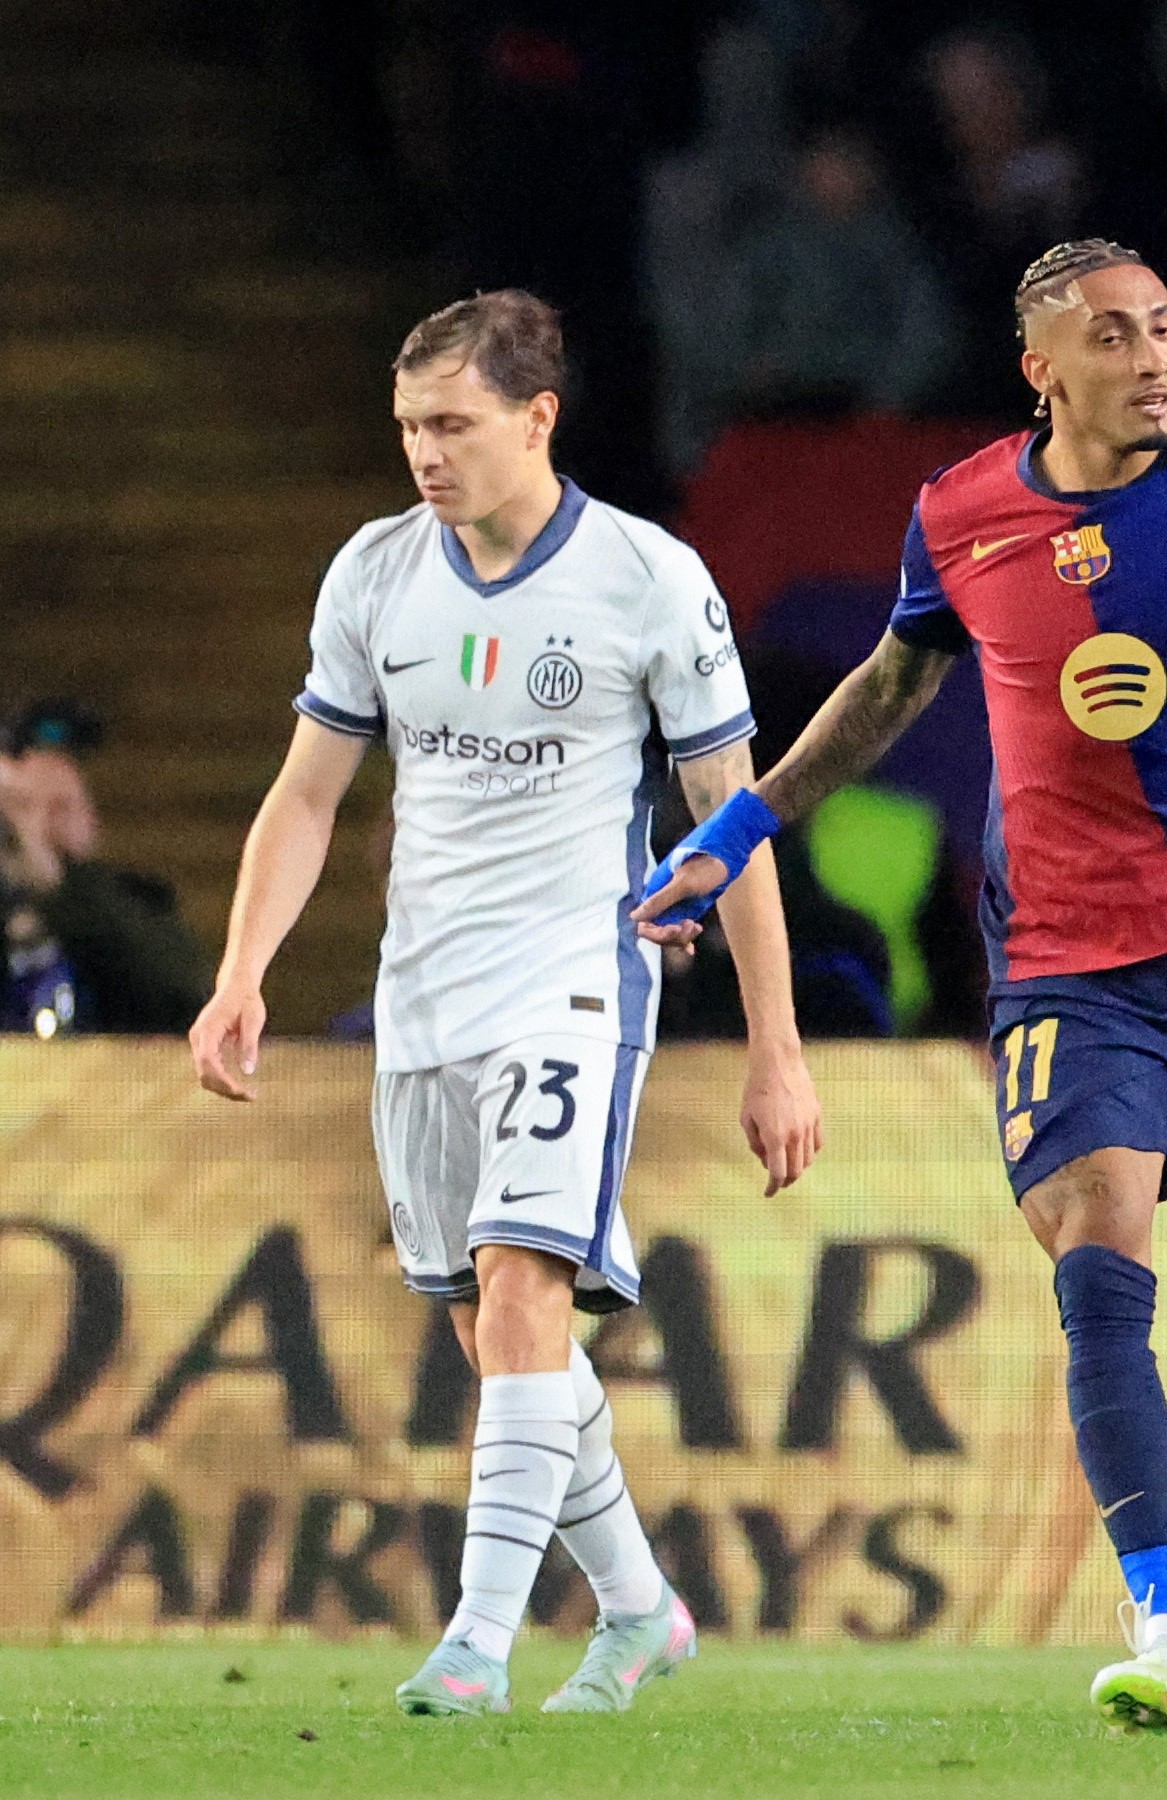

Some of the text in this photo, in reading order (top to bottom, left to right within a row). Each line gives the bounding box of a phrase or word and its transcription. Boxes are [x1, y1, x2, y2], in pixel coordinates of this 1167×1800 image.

[397, 717, 565, 766] betsson
[495, 1058, 580, 1142] 23
[1004, 1018, 1059, 1113] 11
[0, 1216, 980, 1498] QAAR
